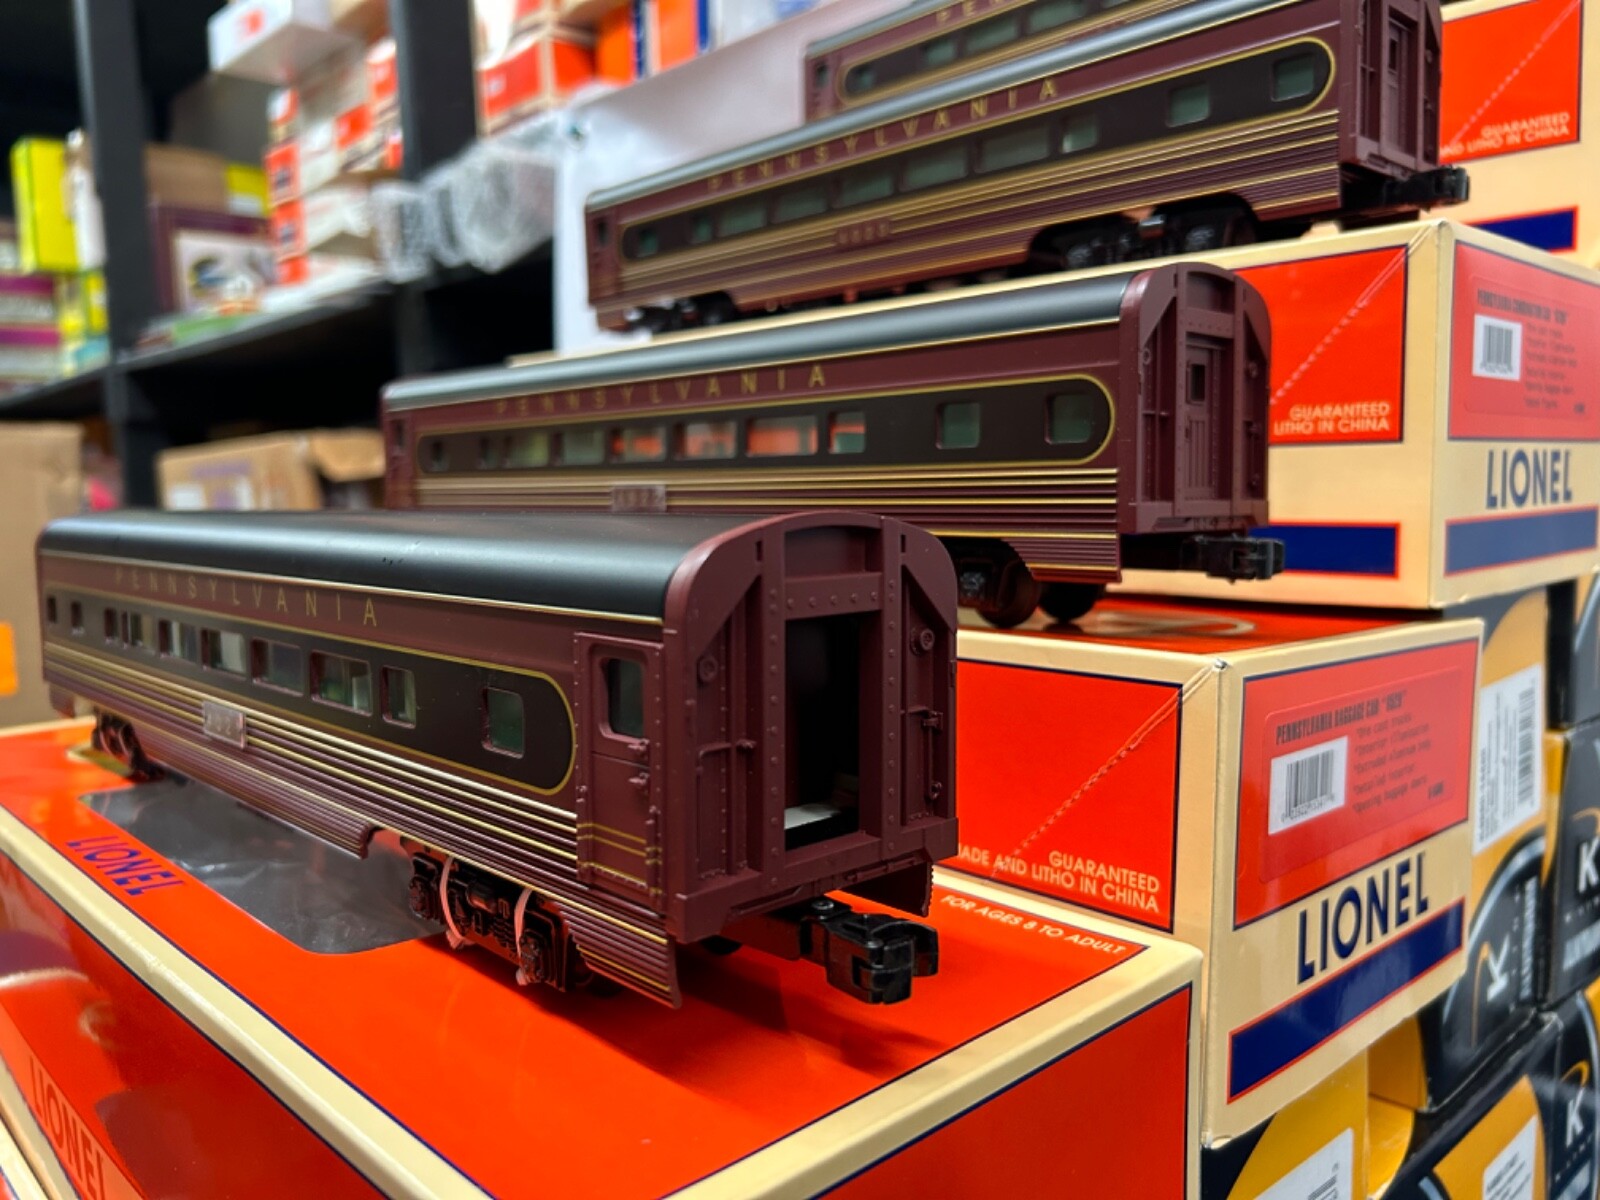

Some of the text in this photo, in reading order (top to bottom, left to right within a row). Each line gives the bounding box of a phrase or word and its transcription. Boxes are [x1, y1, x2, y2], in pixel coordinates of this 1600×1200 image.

[1481, 112, 1570, 139] GUARANTEED
[1524, 125, 1569, 143] CHINA
[495, 364, 825, 416] PENNSYLVANIA
[1289, 402, 1390, 421] GUARANTEED
[1273, 417, 1390, 436] LITHO IN CHINA
[1486, 449, 1573, 510] LIONEL
[115, 566, 377, 627] PENNSYLVANIA
[66, 835, 187, 896] LIONEL
[958, 841, 1159, 914] ADE AND LITHO IN CHINA
[1048, 849, 1160, 893] GUARANTEED
[941, 894, 1127, 955] FOR AGES 8 TO ADULT
[1297, 850, 1429, 986] LIONEL
